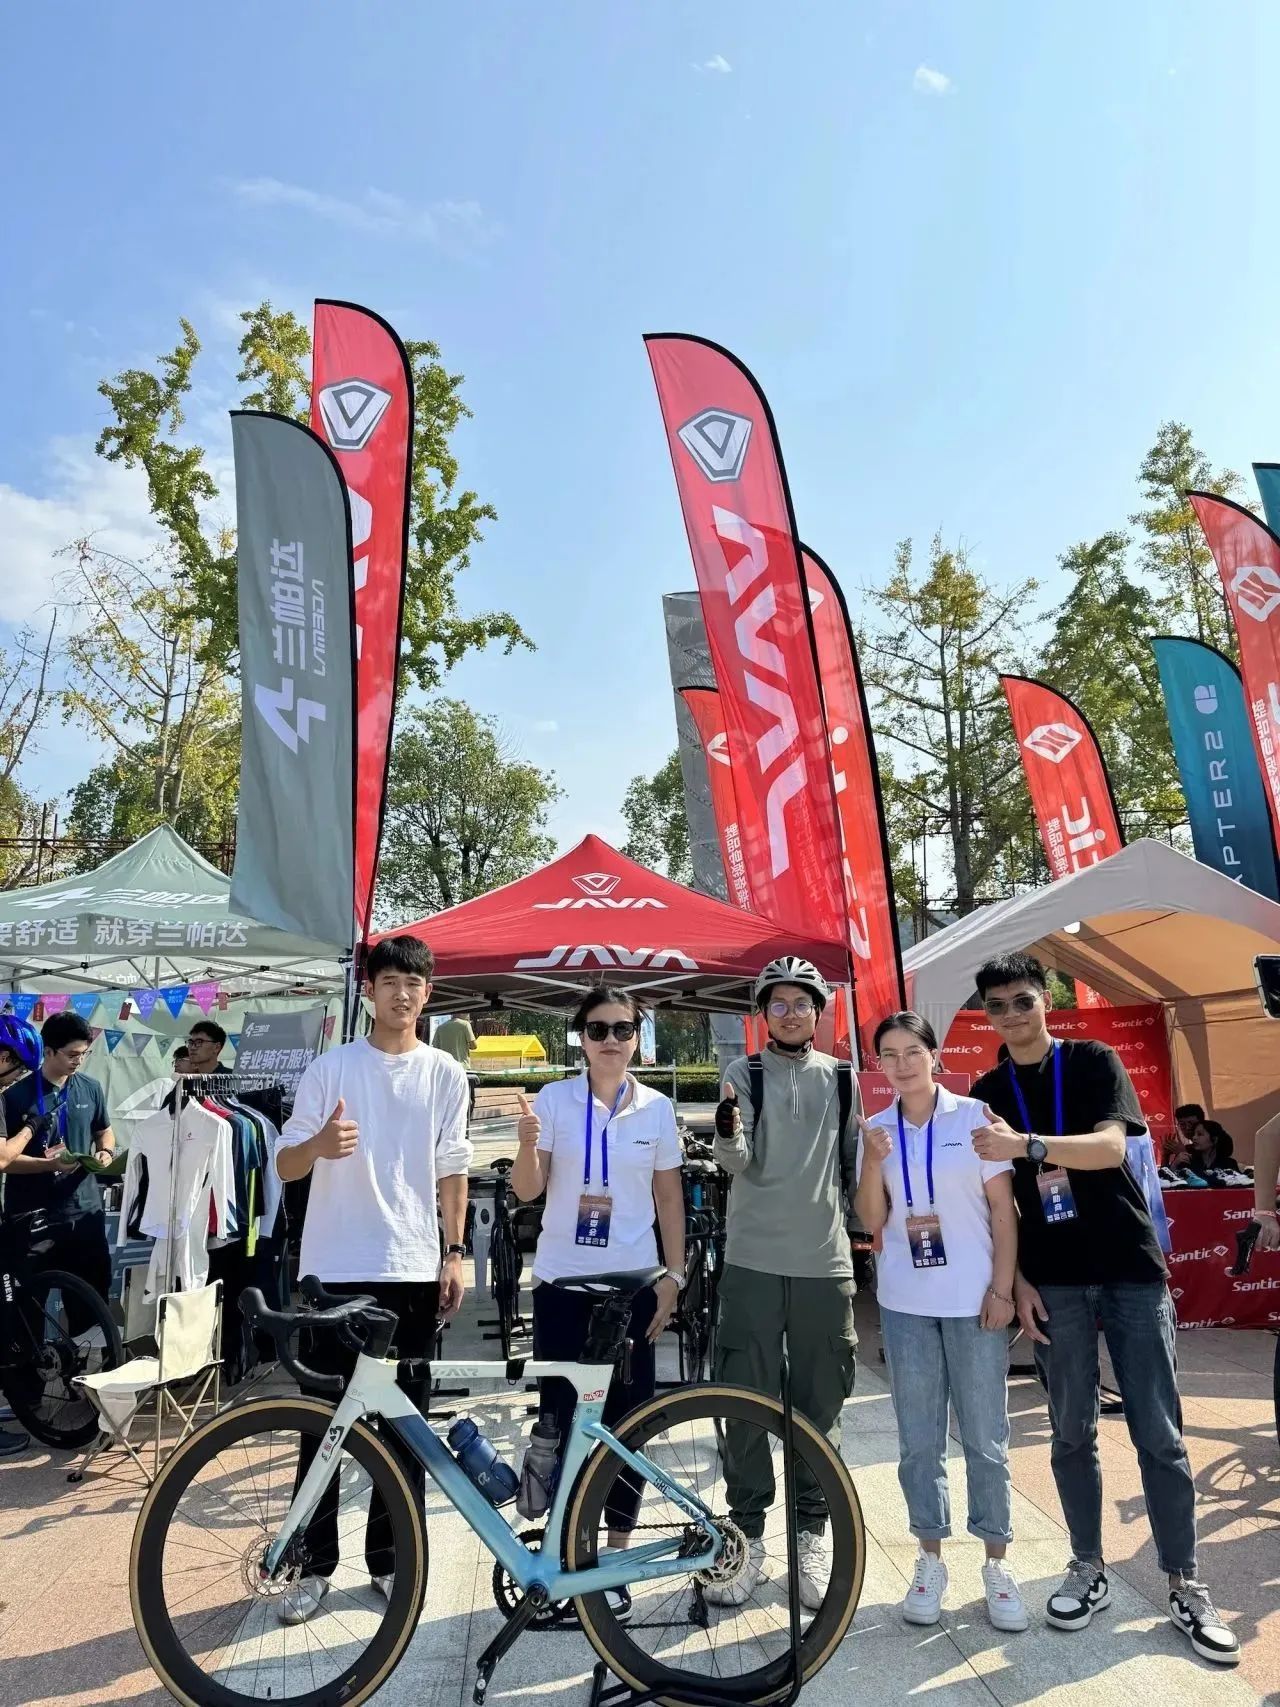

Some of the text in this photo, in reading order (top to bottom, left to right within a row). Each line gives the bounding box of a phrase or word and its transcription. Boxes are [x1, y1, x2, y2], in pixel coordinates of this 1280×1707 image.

[269, 538, 305, 670] 兰帕达
[532, 897, 668, 909] JAVA
[94, 917, 249, 948] 就穿兰帕达
[514, 944, 699, 970] JAVA
[1045, 1022, 1076, 1030] antic
[1111, 1018, 1144, 1029] Santic
[941, 1045, 971, 1055] antic
[1223, 1208, 1257, 1221] Sant
[1168, 1247, 1212, 1265] Santic
[1232, 1277, 1280, 1292] Santic
